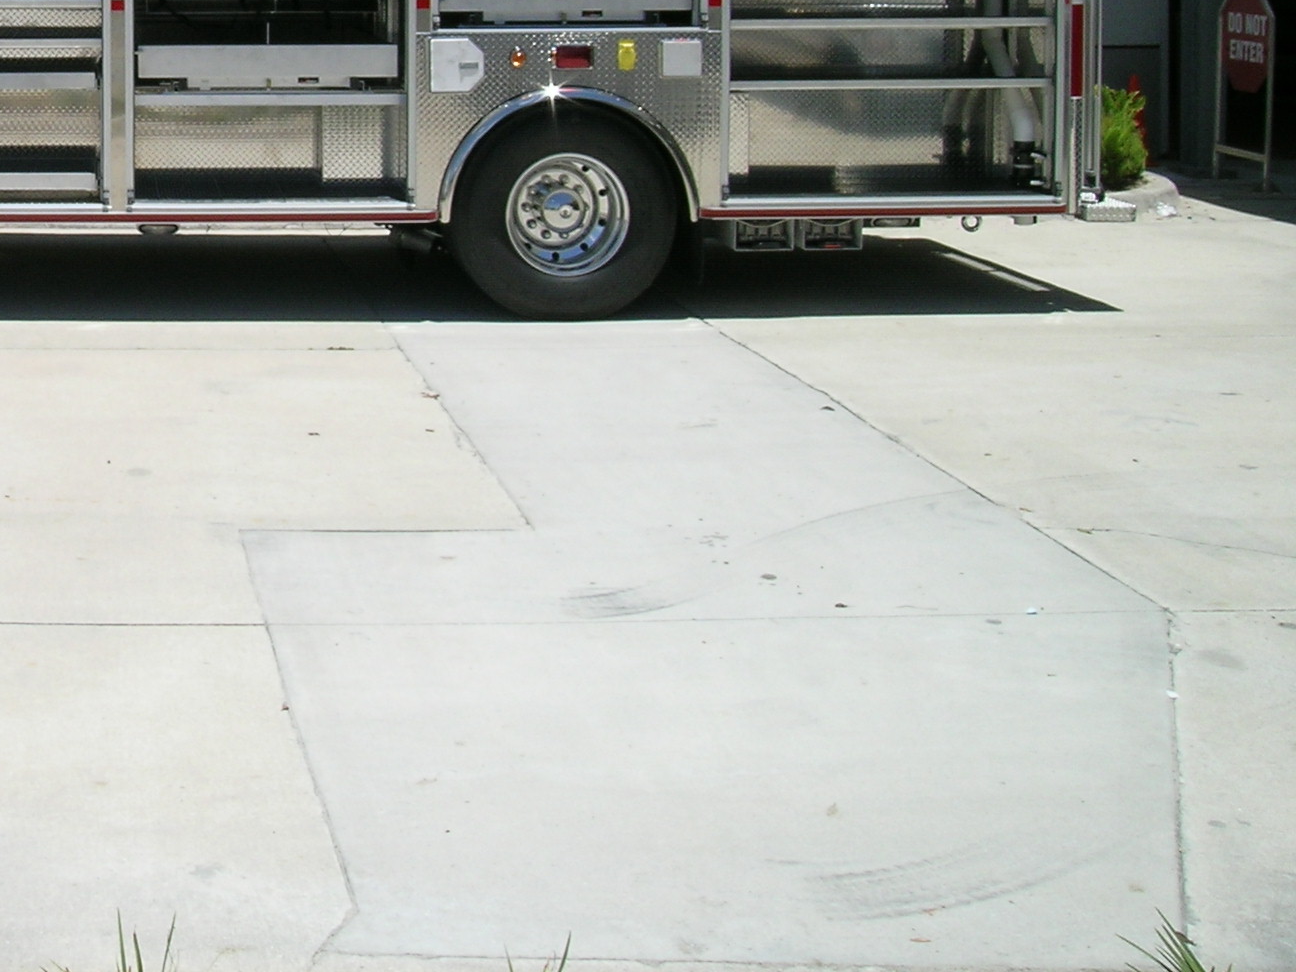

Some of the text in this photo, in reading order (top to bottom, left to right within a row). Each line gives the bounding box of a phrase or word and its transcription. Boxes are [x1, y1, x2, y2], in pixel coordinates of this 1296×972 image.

[1228, 12, 1267, 36] DO NOT
[1229, 39, 1264, 63] ENTER
